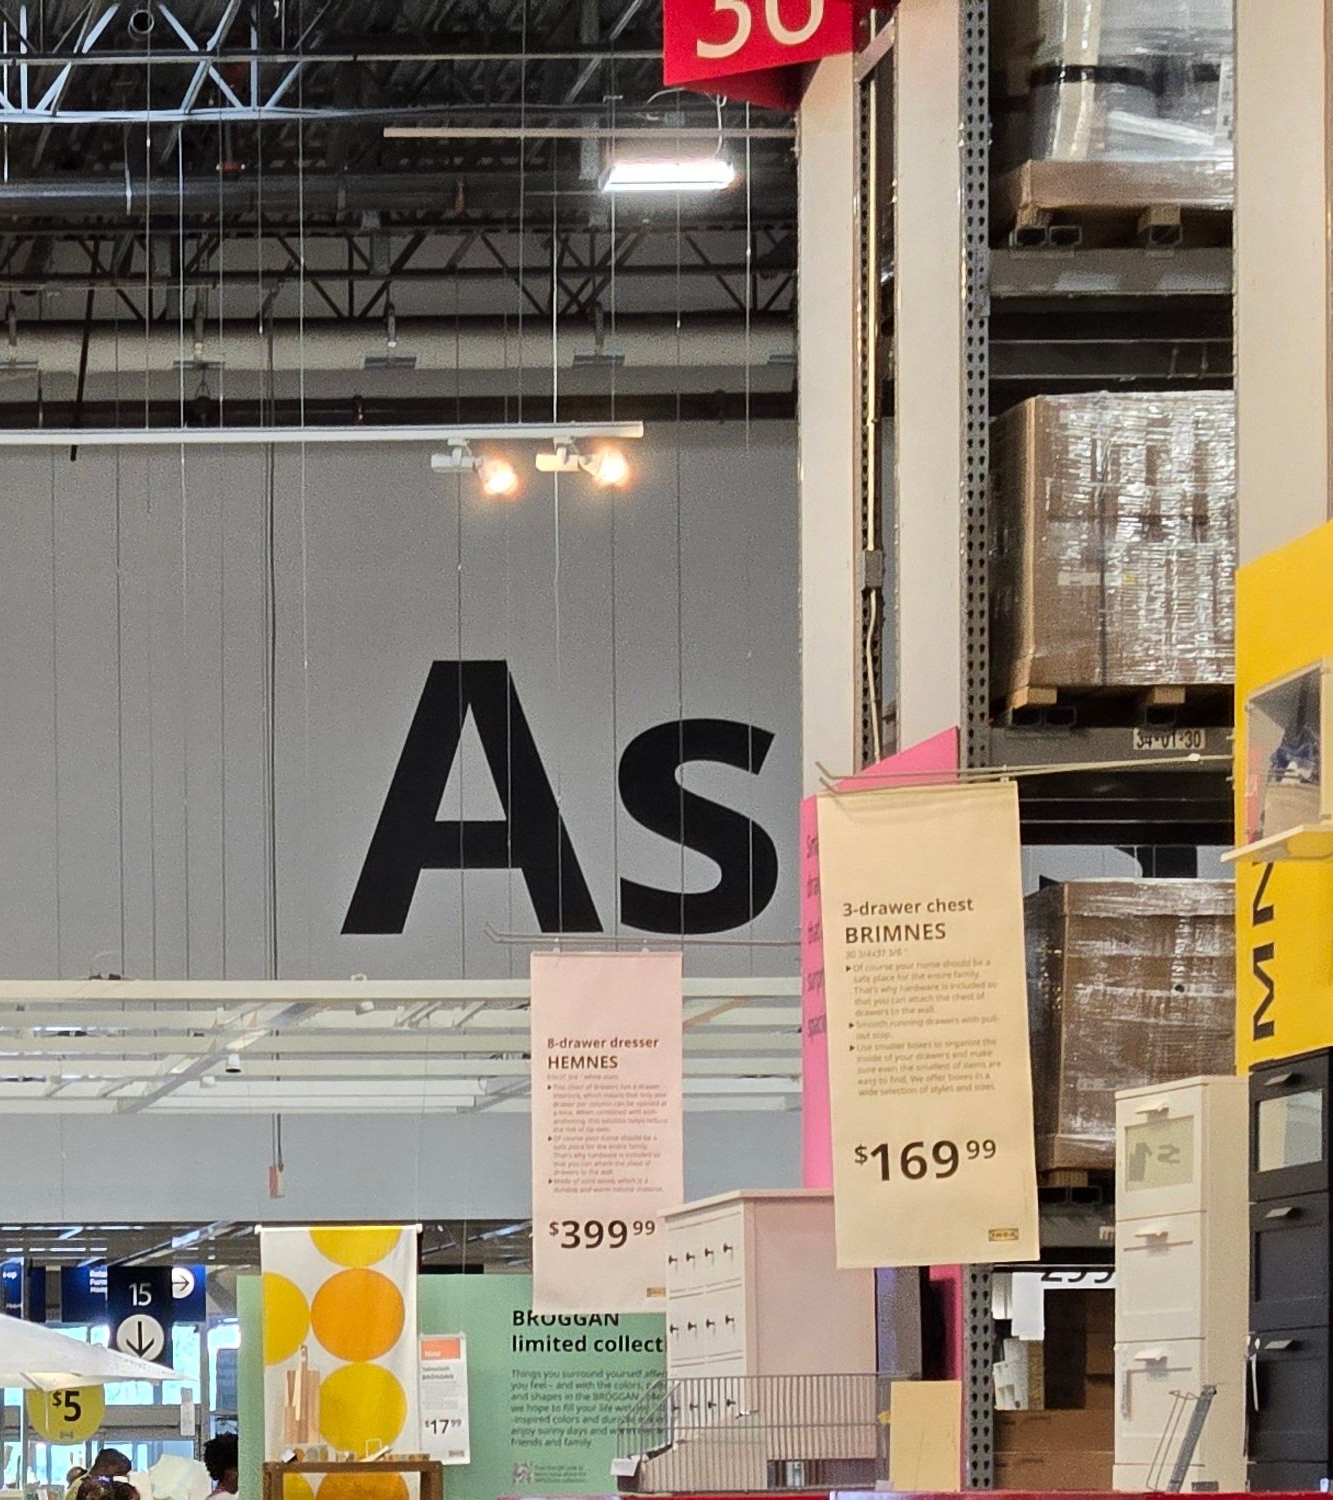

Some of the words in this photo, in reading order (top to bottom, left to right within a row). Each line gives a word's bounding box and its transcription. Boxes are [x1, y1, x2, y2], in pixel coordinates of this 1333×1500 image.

[339, 659, 780, 936] As
[843, 901, 922, 917] 3-drawer
[926, 898, 974, 913] chest
[845, 922, 947, 944] BRIMNES
[547, 1037, 606, 1049] 8-drawer
[609, 1036, 659, 1048] dresser
[547, 1055, 619, 1070] HEMNES
[128, 1282, 152, 1307] 15
[512, 1335, 587, 1352] limited
[594, 1335, 666, 1352] collect
[52, 1390, 82, 1422] $5
